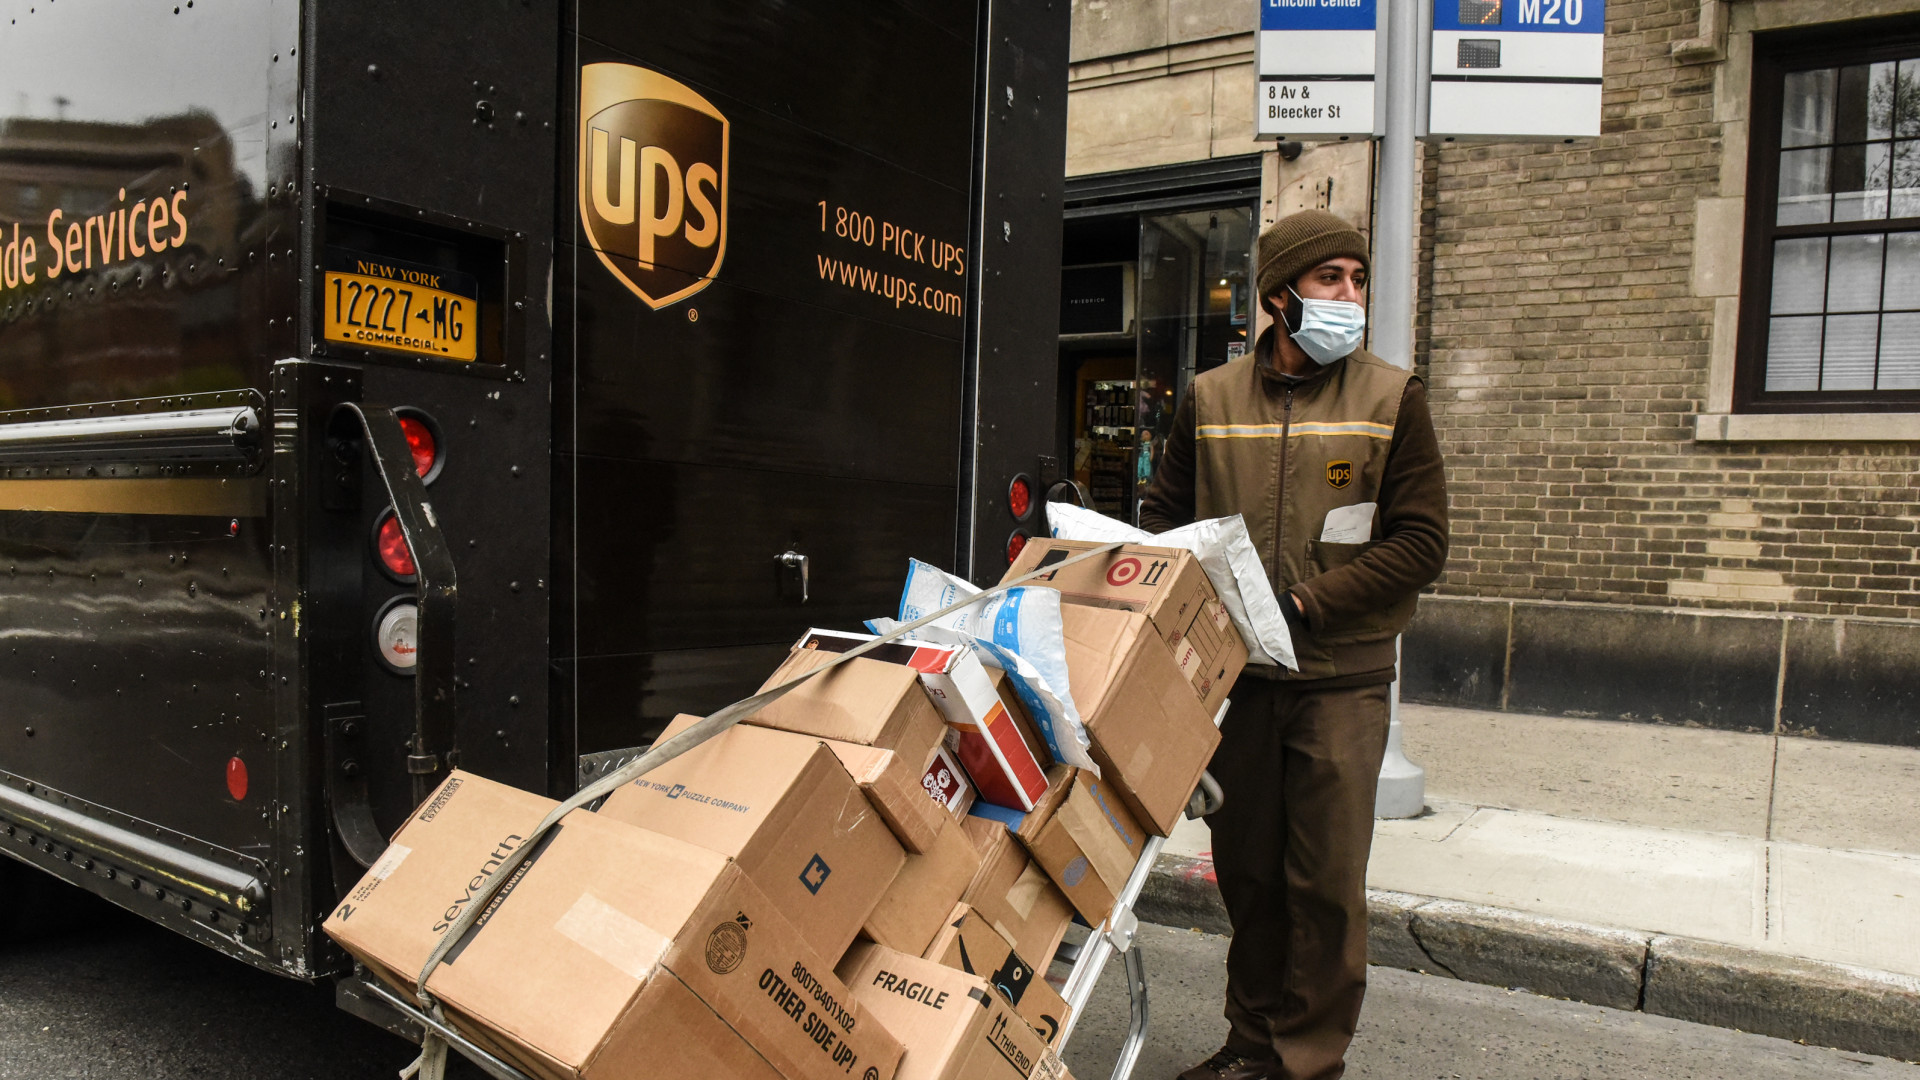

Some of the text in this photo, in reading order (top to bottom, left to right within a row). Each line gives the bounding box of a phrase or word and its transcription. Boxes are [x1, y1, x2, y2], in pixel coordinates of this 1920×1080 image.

[1518, 0, 1583, 25] M20
[1268, 85, 1310, 99] 8 Av &
[1268, 105, 1341, 118] Bleecker St
[592, 127, 719, 271] ups
[47, 187, 188, 279] Services
[818, 200, 964, 276] 1 800 PICK UPS
[357, 260, 440, 289] NEW YORK
[817, 254, 962, 317] www.ups.com
[332, 277, 463, 342] 12227 MG
[355, 329, 440, 351] COMMERCIAL
[1327, 468, 1351, 484] ups
[633, 779, 750, 814] NEW YORK PUZZLE COMPANY
[432, 834, 522, 935] seventh
[476, 859, 532, 926] PAPER TOWELS
[336, 904, 357, 922] 2
[791, 961, 855, 1034] 80078401X02
[872, 969, 950, 1010] FRAGILE
[758, 968, 857, 1074] OTHER SIDE UP!
[1000, 1033, 1030, 1070] THIS END
